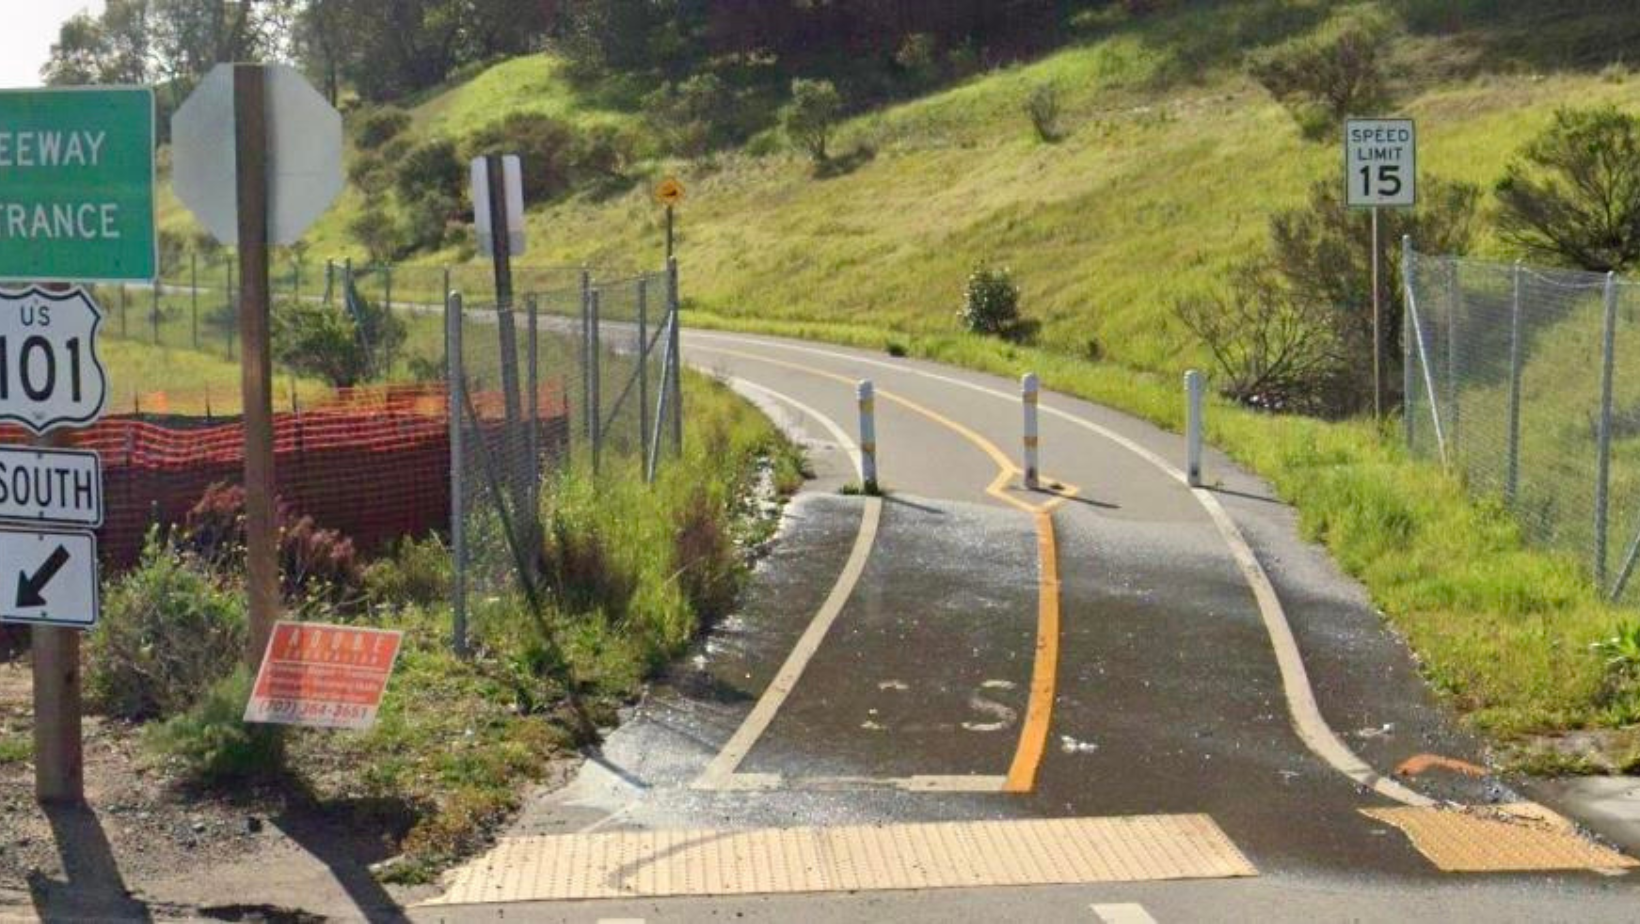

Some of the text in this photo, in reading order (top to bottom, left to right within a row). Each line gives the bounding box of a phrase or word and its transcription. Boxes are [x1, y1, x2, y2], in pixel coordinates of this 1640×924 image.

[1351, 128, 1410, 142] SPEED
[1357, 147, 1403, 161] LIMIT
[1359, 165, 1401, 196] 15
[0, 202, 120, 238] RANCE
[20, 305, 51, 326] US
[0, 335, 81, 403] 101
